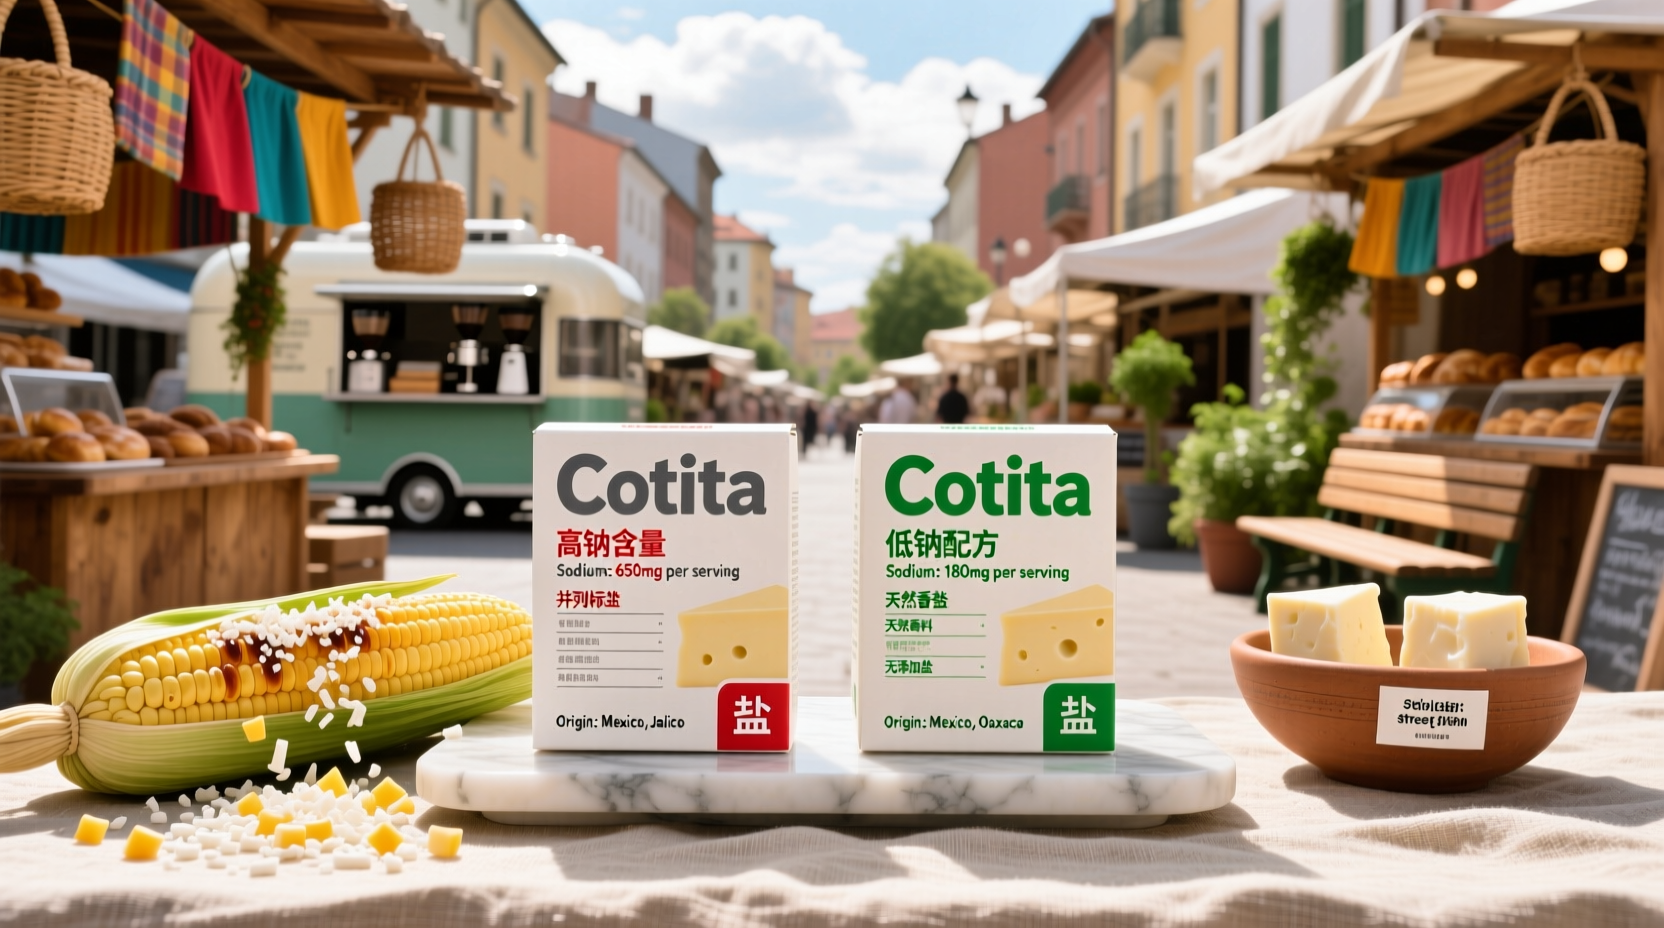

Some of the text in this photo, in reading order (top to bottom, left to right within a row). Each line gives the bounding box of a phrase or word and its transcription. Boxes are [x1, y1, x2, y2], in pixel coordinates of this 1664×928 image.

[557, 453, 767, 516] Cotita
[885, 454, 1092, 517] Cotita
[557, 528, 666, 558] 高钠含量
[885, 529, 999, 559] 低钠配方
[556, 563, 740, 582] Sodium: 650mg per serving
[885, 564, 1070, 582] Sodium: 180mg per serving
[556, 714, 685, 731] Origin: Mexico, Jalico
[733, 695, 771, 735] 盐
[884, 715, 926, 732] Origin:
[929, 715, 976, 732] Mexico,
[1060, 695, 1097, 735] 盐
